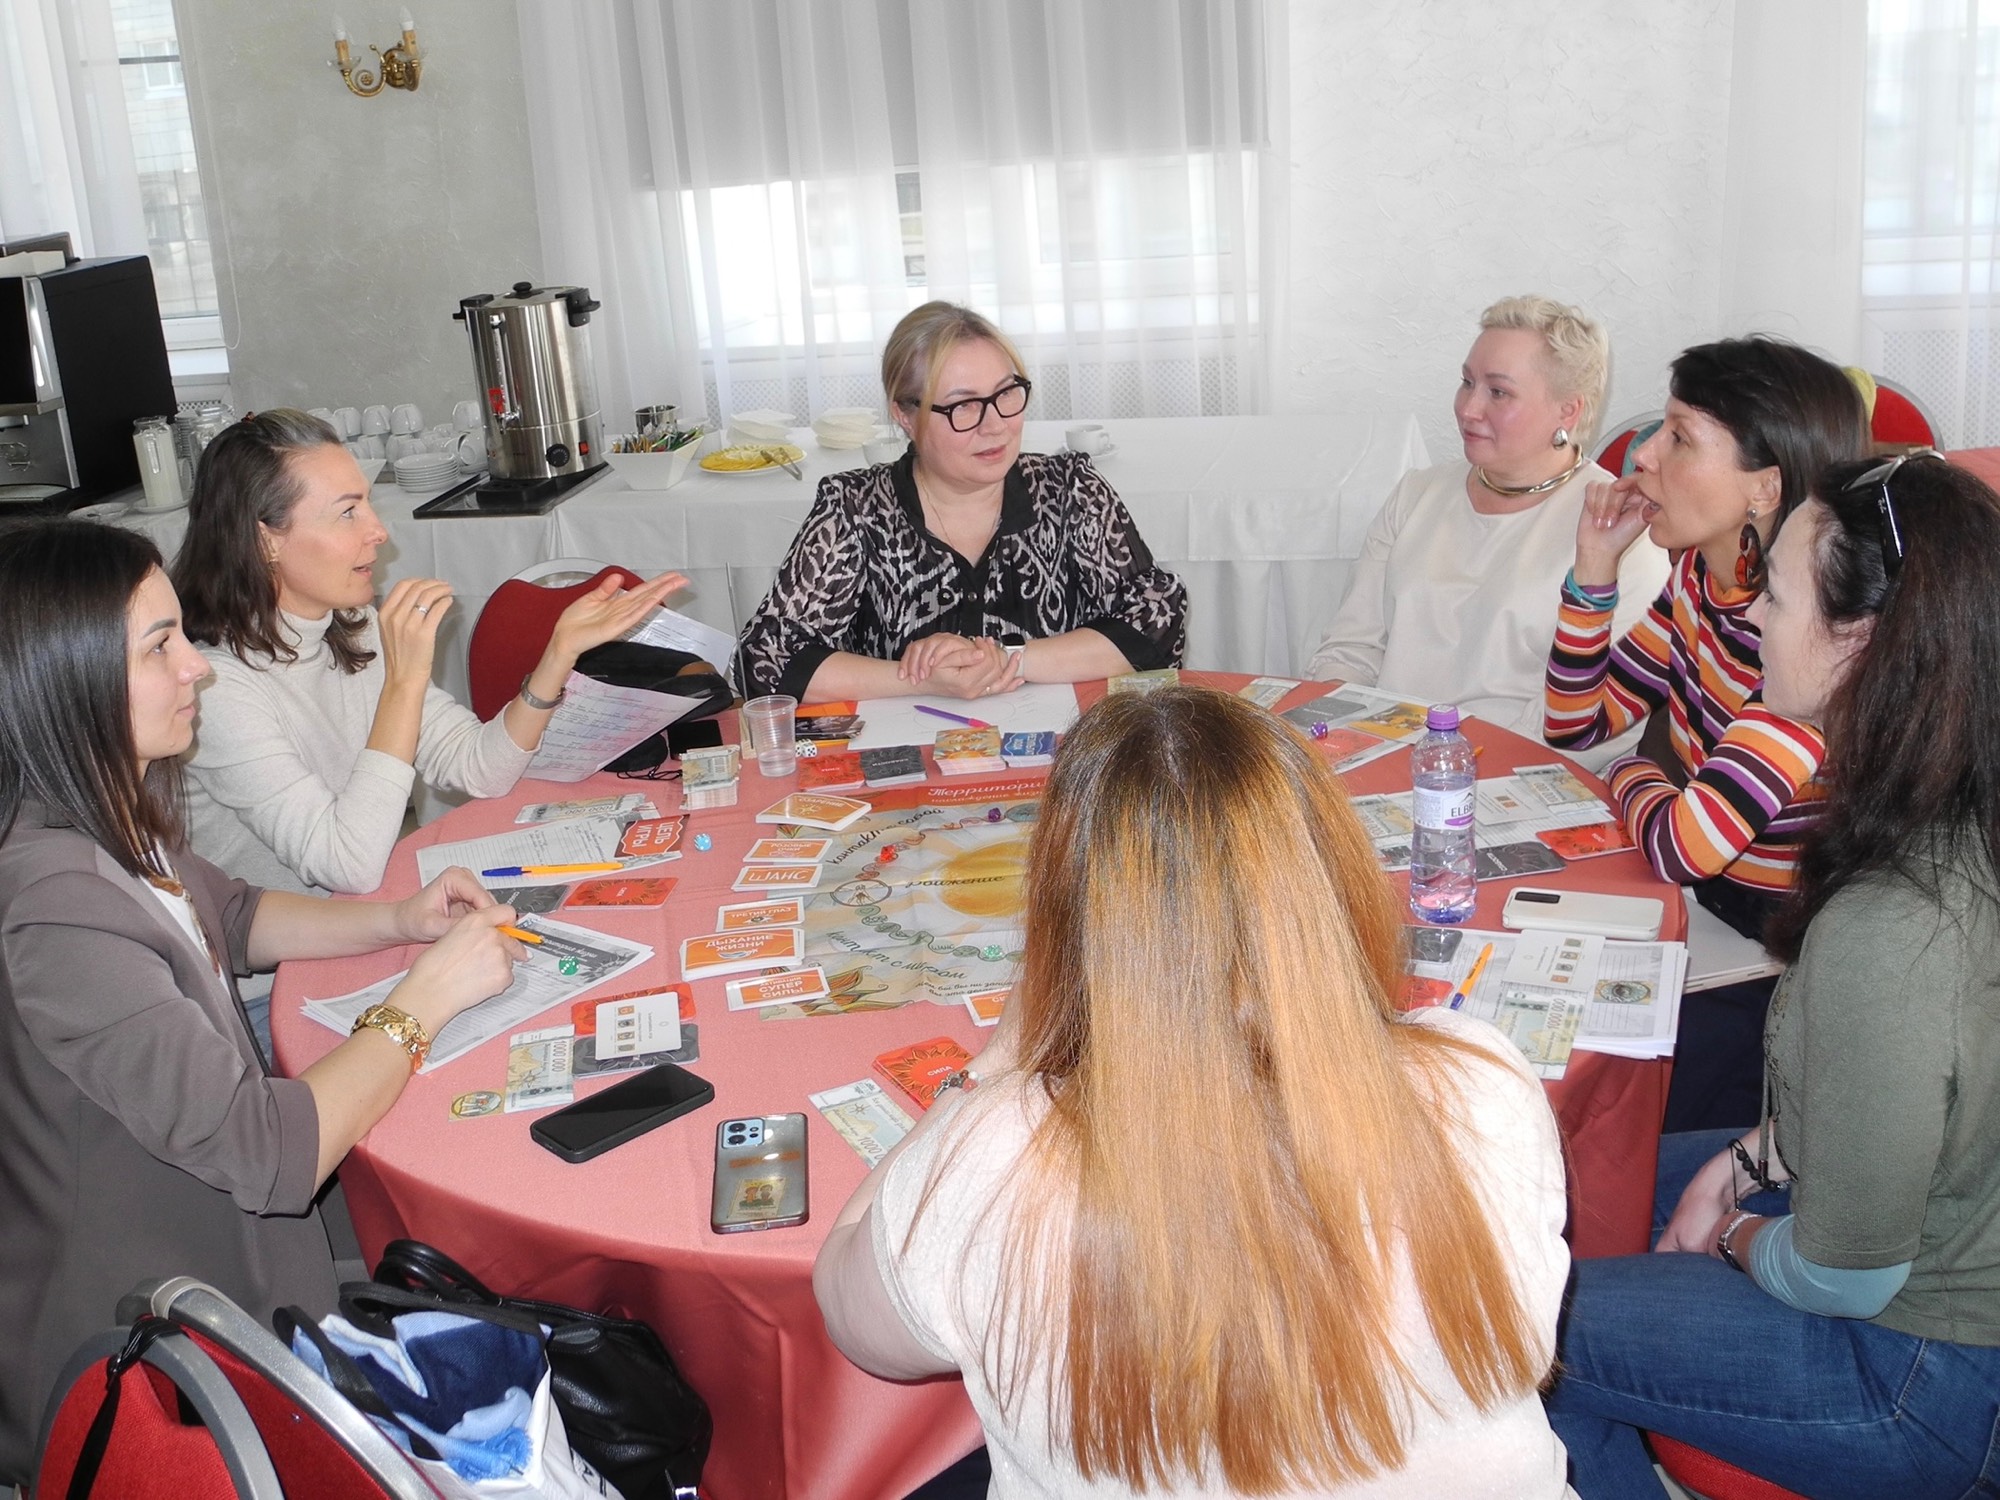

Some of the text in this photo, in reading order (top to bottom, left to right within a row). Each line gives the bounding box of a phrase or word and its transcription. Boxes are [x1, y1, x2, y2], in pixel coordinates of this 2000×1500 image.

[928, 780, 1047, 798] Территори
[631, 824, 653, 848] ИГРЫ
[654, 821, 675, 845] ЦЕЛЬ
[748, 870, 809, 882] ШАНС
[731, 907, 791, 918] ТРЕТИЙ ГЛАЗ
[705, 934, 774, 948] ДЫХАНИЕ
[716, 941, 765, 952] ЖИЗНИ
[902, 961, 967, 979] миром
[759, 980, 803, 992] СУПЕР
[762, 987, 804, 998] СИЛЫ
[551, 1039, 568, 1073] 1000 000
[927, 1065, 953, 1077] СИЛА
[858, 1136, 879, 1155] 1000
